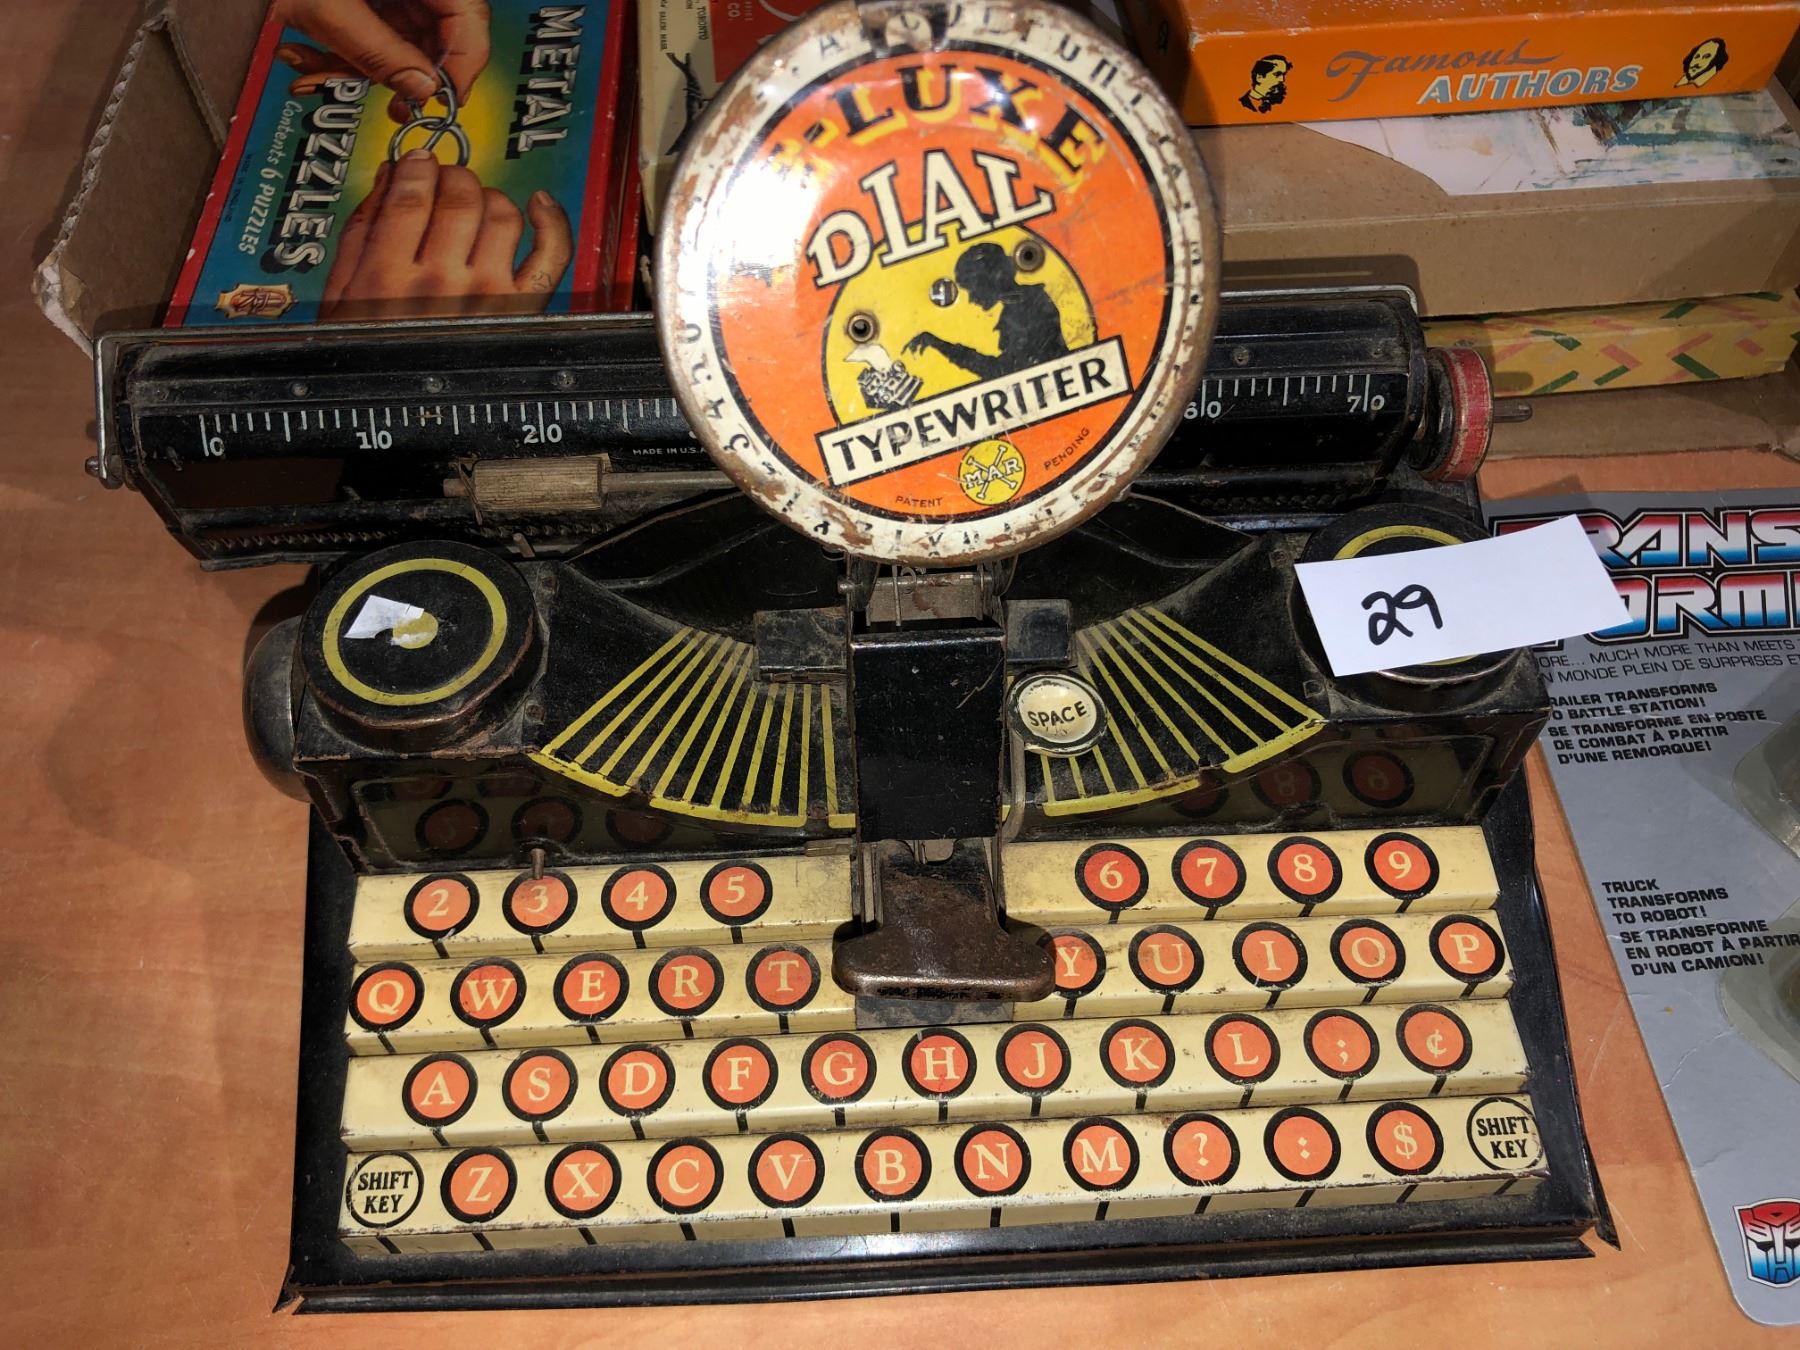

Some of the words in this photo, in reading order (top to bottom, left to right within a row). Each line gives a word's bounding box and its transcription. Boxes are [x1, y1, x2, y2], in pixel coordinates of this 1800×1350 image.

[518, 3, 586, 154] METAL
[1325, 38, 1566, 102] Famous
[1417, 64, 1643, 107] AUTHORS
[266, 100, 303, 165] Contents
[260, 168, 284, 180] 6
[273, 76, 370, 266] PUZZLES
[238, 183, 276, 255] PUZZLES
[806, 148, 1053, 288] DIAL
[832, 357, 1111, 472] TYPEWRITER
[632, 448, 663, 456] MADE
[666, 447, 678, 455] IN
[895, 495, 943, 508] PATENT
[1043, 426, 1091, 471] PENDING
[964, 456, 1023, 490] MAR
[1360, 583, 1444, 646] 29
[1538, 655, 1586, 669] ORE...
[1590, 650, 1640, 664] MUCH
[1644, 643, 1693, 658] MORE
[1696, 640, 1739, 655] THAN
[1743, 639, 1796, 651] MEETS
[1558, 665, 1619, 683] MONDE
[1623, 661, 1668, 677] PLEIN
[1672, 659, 1695, 672] DE
[1699, 654, 1783, 671] SURPRISES
[1549, 694, 1602, 707] RAILER
[1605, 682, 1718, 703] TRANSFORMS
[1568, 705, 1625, 719] BATTLE
[1629, 697, 1706, 716] STATION!
[1026, 700, 1088, 728] SPACE
[1548, 726, 1570, 738] SE
[1573, 716, 1684, 736] TRANSFORME
[1689, 713, 1710, 725] EN
[1715, 709, 1767, 723] POSTE
[1553, 739, 1575, 751] DE
[1578, 733, 1646, 749] COMBAT
[1653, 728, 1665, 742] À
[1670, 725, 1729, 740] PARTIR
[1557, 750, 1608, 765] D'UNE
[1612, 740, 1712, 761] REMORQUE!
[426, 886, 451, 919] 2
[526, 884, 550, 915] 3
[624, 879, 651, 912] 4
[724, 874, 747, 905] 5
[1099, 860, 1124, 889] 6
[1196, 857, 1218, 887] 7
[1293, 853, 1317, 883] 8
[1388, 850, 1413, 880] 9
[1602, 879, 1660, 894] TRUCK
[1607, 888, 1729, 909] TRANSFORMS
[1613, 912, 1636, 924] TO
[1640, 905, 1707, 923] ROBOT!
[1620, 931, 1642, 944] SE
[1645, 919, 1769, 942] TRANSFORME
[1625, 946, 1650, 959] EN
[1655, 940, 1714, 957] ROBOT
[1721, 937, 1735, 951] À
[1738, 933, 1800, 950] PARTIR
[368, 979, 405, 1016] Q
[466, 977, 513, 1012] W
[577, 969, 606, 1003] E
[671, 964, 704, 998] R
[767, 959, 800, 992] T
[1055, 945, 1083, 977] Y
[1150, 943, 1185, 977] U
[1258, 940, 1282, 973] I
[1449, 933, 1481, 966] P
[1631, 961, 1677, 976] D'UN
[1681, 953, 1764, 972] CAMION!
[419, 1071, 456, 1107] A
[526, 1066, 552, 1103] S
[621, 1059, 657, 1097] D
[727, 1056, 753, 1092] F
[822, 1051, 857, 1086] G
[920, 1045, 961, 1081] H
[1022, 1041, 1047, 1080] J
[1118, 1036, 1160, 1072] K
[1227, 1032, 1260, 1067] L
[1477, 1115, 1531, 1137] SHIFT
[464, 1166, 494, 1204] Z
[561, 1161, 603, 1201] X
[667, 1155, 701, 1197] C
[767, 1153, 808, 1191] V
[873, 1148, 907, 1189] B
[971, 1142, 1010, 1180] N
[1076, 1135, 1124, 1175] M
[1193, 1131, 1210, 1170] ?
[1392, 1121, 1419, 1160] $
[1490, 1138, 1529, 1159] KEY
[357, 1170, 414, 1192] SHIFT
[364, 1193, 403, 1214] KEY
